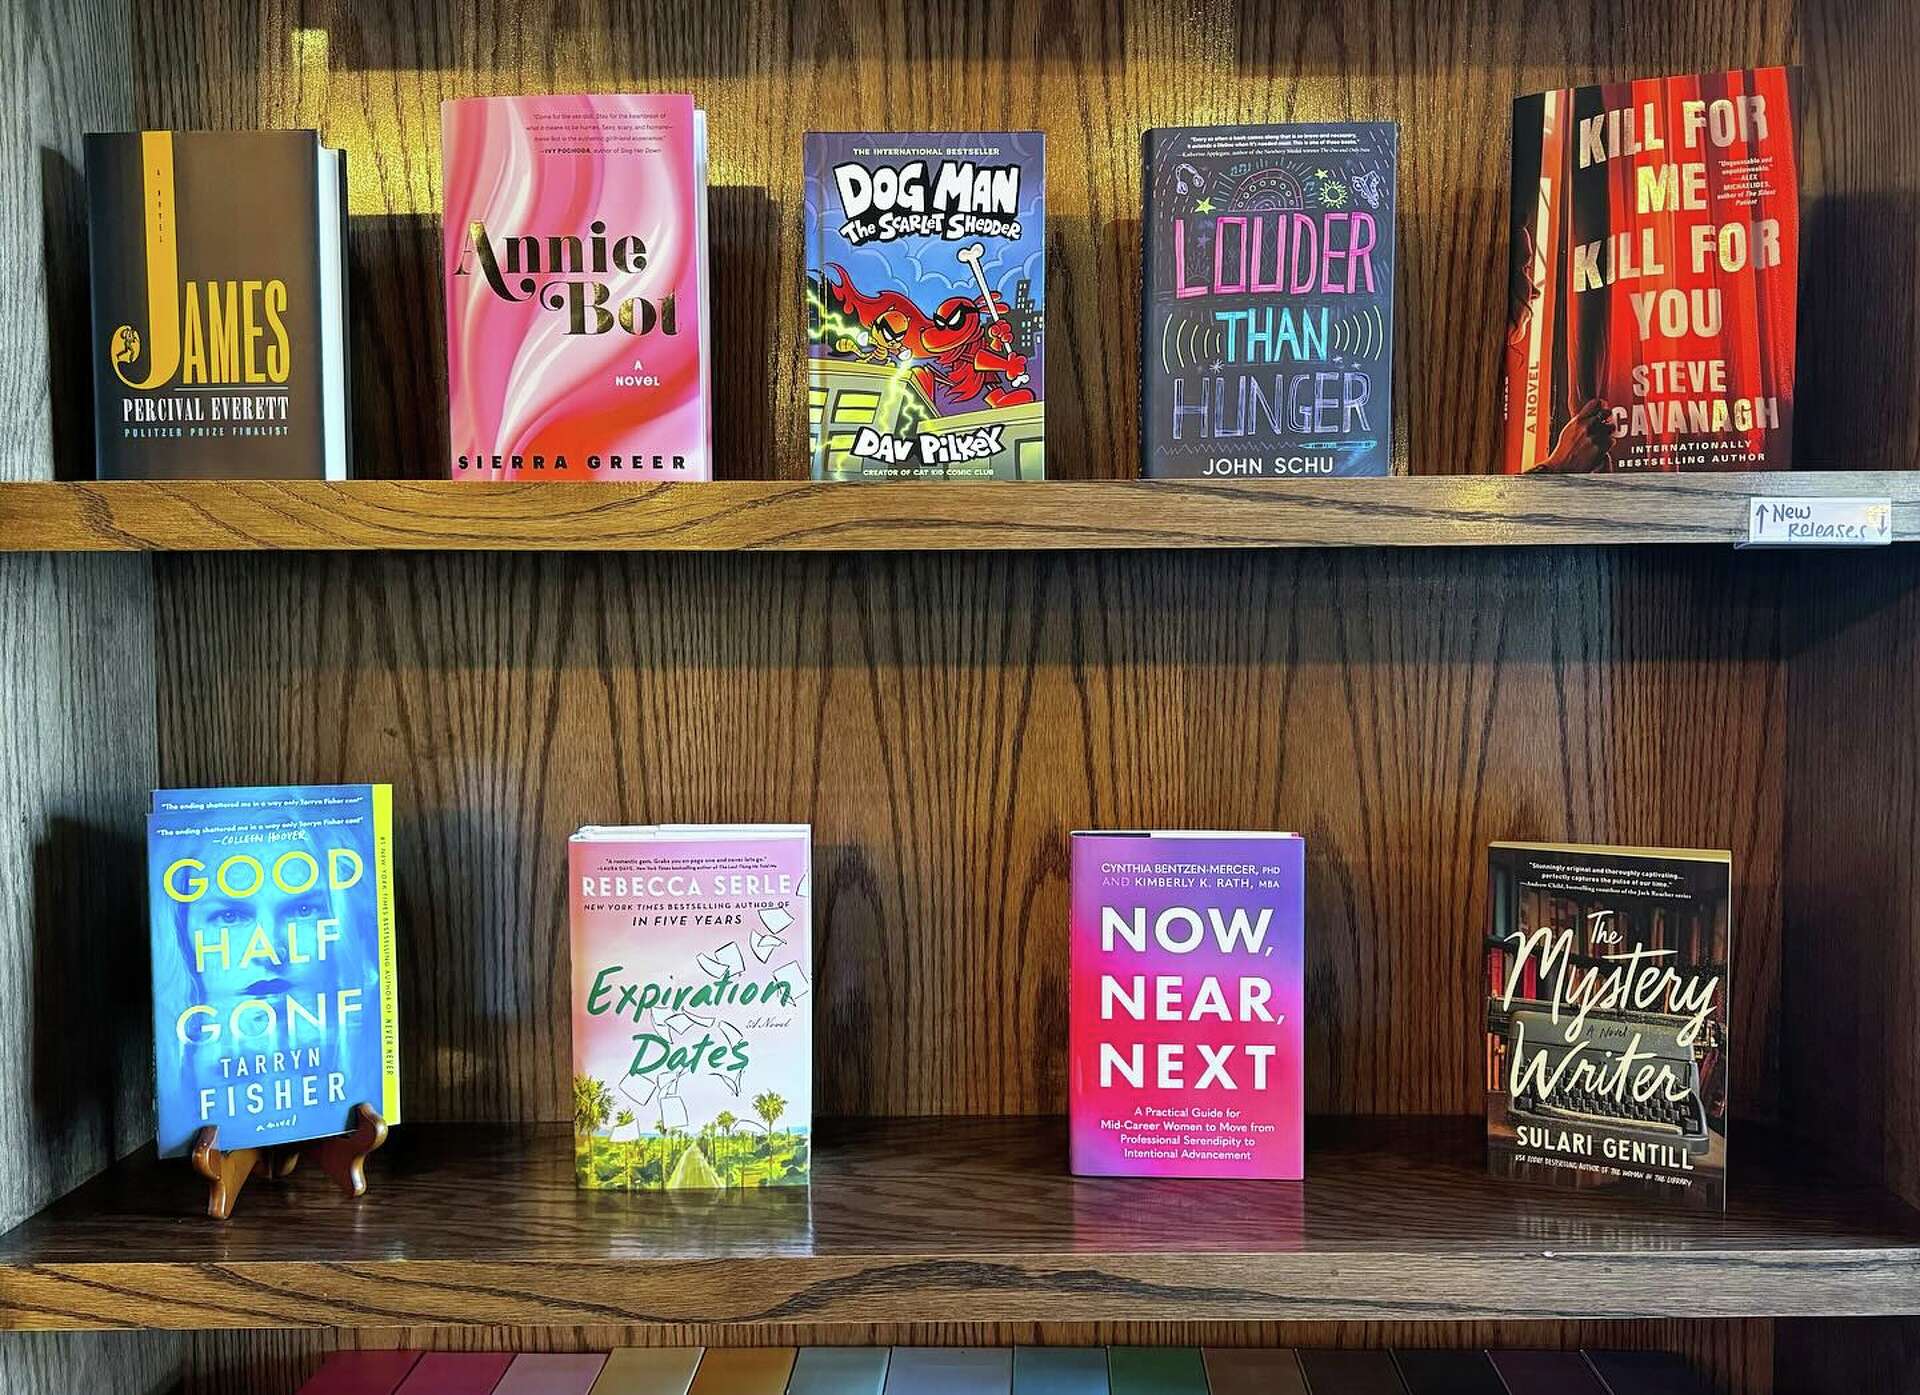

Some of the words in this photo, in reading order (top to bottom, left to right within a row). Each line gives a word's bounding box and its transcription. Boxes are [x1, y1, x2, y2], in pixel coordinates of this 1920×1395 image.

[1579, 101, 1665, 169] KILL
[1683, 93, 1769, 149] FOR
[946, 148, 1000, 156] BESTSELLER
[835, 162, 925, 219] DOG
[932, 162, 1019, 214] MAN
[1636, 162, 1706, 215] ME
[111, 131, 291, 390] JAMES
[454, 220, 650, 302] Annie
[1175, 211, 1378, 300] LOUDER
[1573, 225, 1665, 293] KILL
[1691, 218, 1780, 275] FOR
[540, 279, 681, 336] Bot
[1629, 287, 1723, 342] YOU
[1215, 306, 1329, 363] THAN
[634, 359, 642, 371] A
[1632, 359, 1727, 397] STEVE
[1172, 371, 1372, 440] HUNGER
[1527, 361, 1539, 417] NOVEL
[123, 397, 205, 422] PERCIVAL
[211, 396, 289, 421] EVERETT
[1612, 397, 1780, 439] CAVANAGH
[124, 427, 183, 438] PULITZER
[190, 427, 225, 437] PRIZE
[232, 426, 289, 436] FINALIST
[854, 427, 914, 464] DAV
[1526, 423, 1537, 434] A
[458, 455, 568, 471] SIERRA
[587, 454, 686, 470] GREER
[1203, 457, 1263, 475] JOHN
[1274, 456, 1334, 475] SCHU
[1618, 455, 1705, 468] BESTSELLING
[1711, 453, 1766, 463] AUTHOR
[1631, 440, 1752, 455] INTERNATIONALLY
[1773, 503, 1811, 522] New
[163, 847, 364, 903] GOOD
[582, 875, 704, 897] REBECCA
[714, 873, 791, 896] SERLE
[1101, 863, 1151, 874] CYNTHIA
[1154, 863, 1259, 876] BENTZEN-MERCER,
[1262, 866, 1281, 874] PHD
[1102, 877, 1129, 887] AND
[1135, 878, 1195, 888] KIMBERLY
[1199, 878, 1211, 888] K.
[1216, 878, 1254, 890] RATH,
[1259, 880, 1280, 889] MBA
[1541, 873, 1570, 881] perfectly
[1600, 876, 1611, 884] the
[1604, 868, 1640, 878] thoroughly
[633, 916, 648, 926] IN
[654, 915, 688, 926] FIVE
[695, 914, 742, 925] YEARS
[636, 903, 665, 911] TIMES
[667, 902, 732, 910] BESTSELLING
[735, 901, 774, 909] AUTHOR
[1102, 906, 1274, 957] NOW,
[1587, 909, 1623, 945] The
[194, 919, 341, 973] HALF
[587, 965, 792, 1023] Expiration
[1101, 975, 1285, 1025] NEAR,
[1504, 926, 1719, 1047] Mystery
[385, 1018, 393, 1045] NEVER
[1600, 1025, 1628, 1038] Novel
[220, 1047, 321, 1079] TARRYN
[386, 1049, 394, 1076] NEVER
[629, 1033, 750, 1077] Dates
[1100, 1043, 1277, 1091] NEXT
[1509, 1020, 1691, 1101] Writer
[199, 1071, 347, 1120] FISHER
[1134, 1107, 1143, 1116] A
[1145, 1107, 1189, 1117] Practical
[1192, 1108, 1223, 1118] Guide
[1226, 1108, 1241, 1118] for
[1100, 1120, 1160, 1131] Mid-Career
[1163, 1121, 1202, 1131] Women
[1206, 1122, 1217, 1132] to
[1219, 1123, 1248, 1132] Move
[1250, 1122, 1275, 1132] from
[1120, 1134, 1180, 1145] Professional
[1183, 1135, 1241, 1148] Serendipity
[1244, 1137, 1256, 1146] to
[1124, 1148, 1178, 1159] Intentional
[1181, 1149, 1251, 1160] Advancement
[1516, 1125, 1592, 1156] SULARI
[1603, 1137, 1694, 1170] GENTILL
